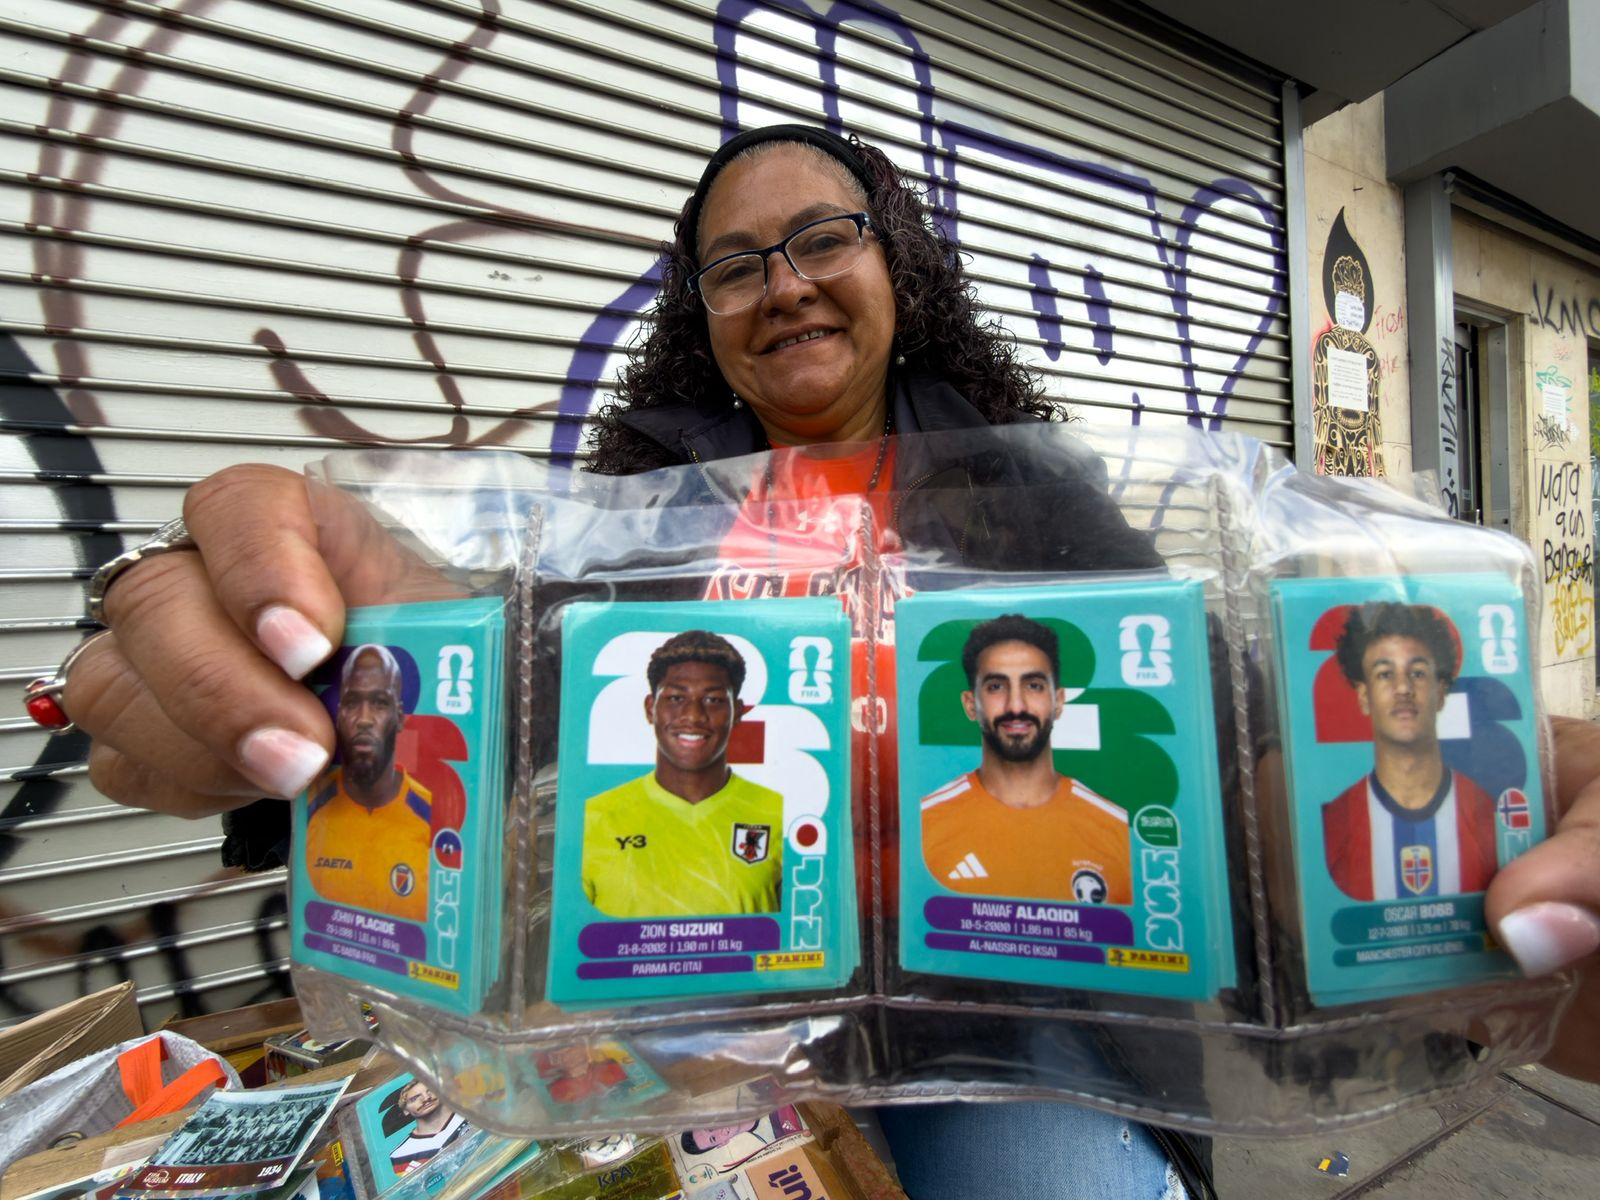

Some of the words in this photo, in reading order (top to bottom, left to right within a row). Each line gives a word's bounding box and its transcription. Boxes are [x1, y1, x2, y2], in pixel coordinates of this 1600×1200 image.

[616, 835, 647, 850] Y-3
[314, 857, 353, 870] SAETA
[972, 903, 1012, 918] NAWAF
[1016, 905, 1079, 923] ALAQIDI
[640, 924, 666, 939] ZION
[669, 922, 723, 937] SUZUKI
[1078, 927, 1092, 941] kg
[699, 942, 708, 951] m
[730, 940, 742, 953] kg
[969, 940, 1018, 954] AL-NASSR
[1019, 942, 1031, 955] FC
[775, 953, 823, 963] PANINI
[1130, 953, 1185, 964] PANINI
[633, 961, 667, 975] PARMA
[669, 961, 681, 973] FC
[174, 1172, 206, 1184] ITALY
[256, 1164, 283, 1178] 1934
